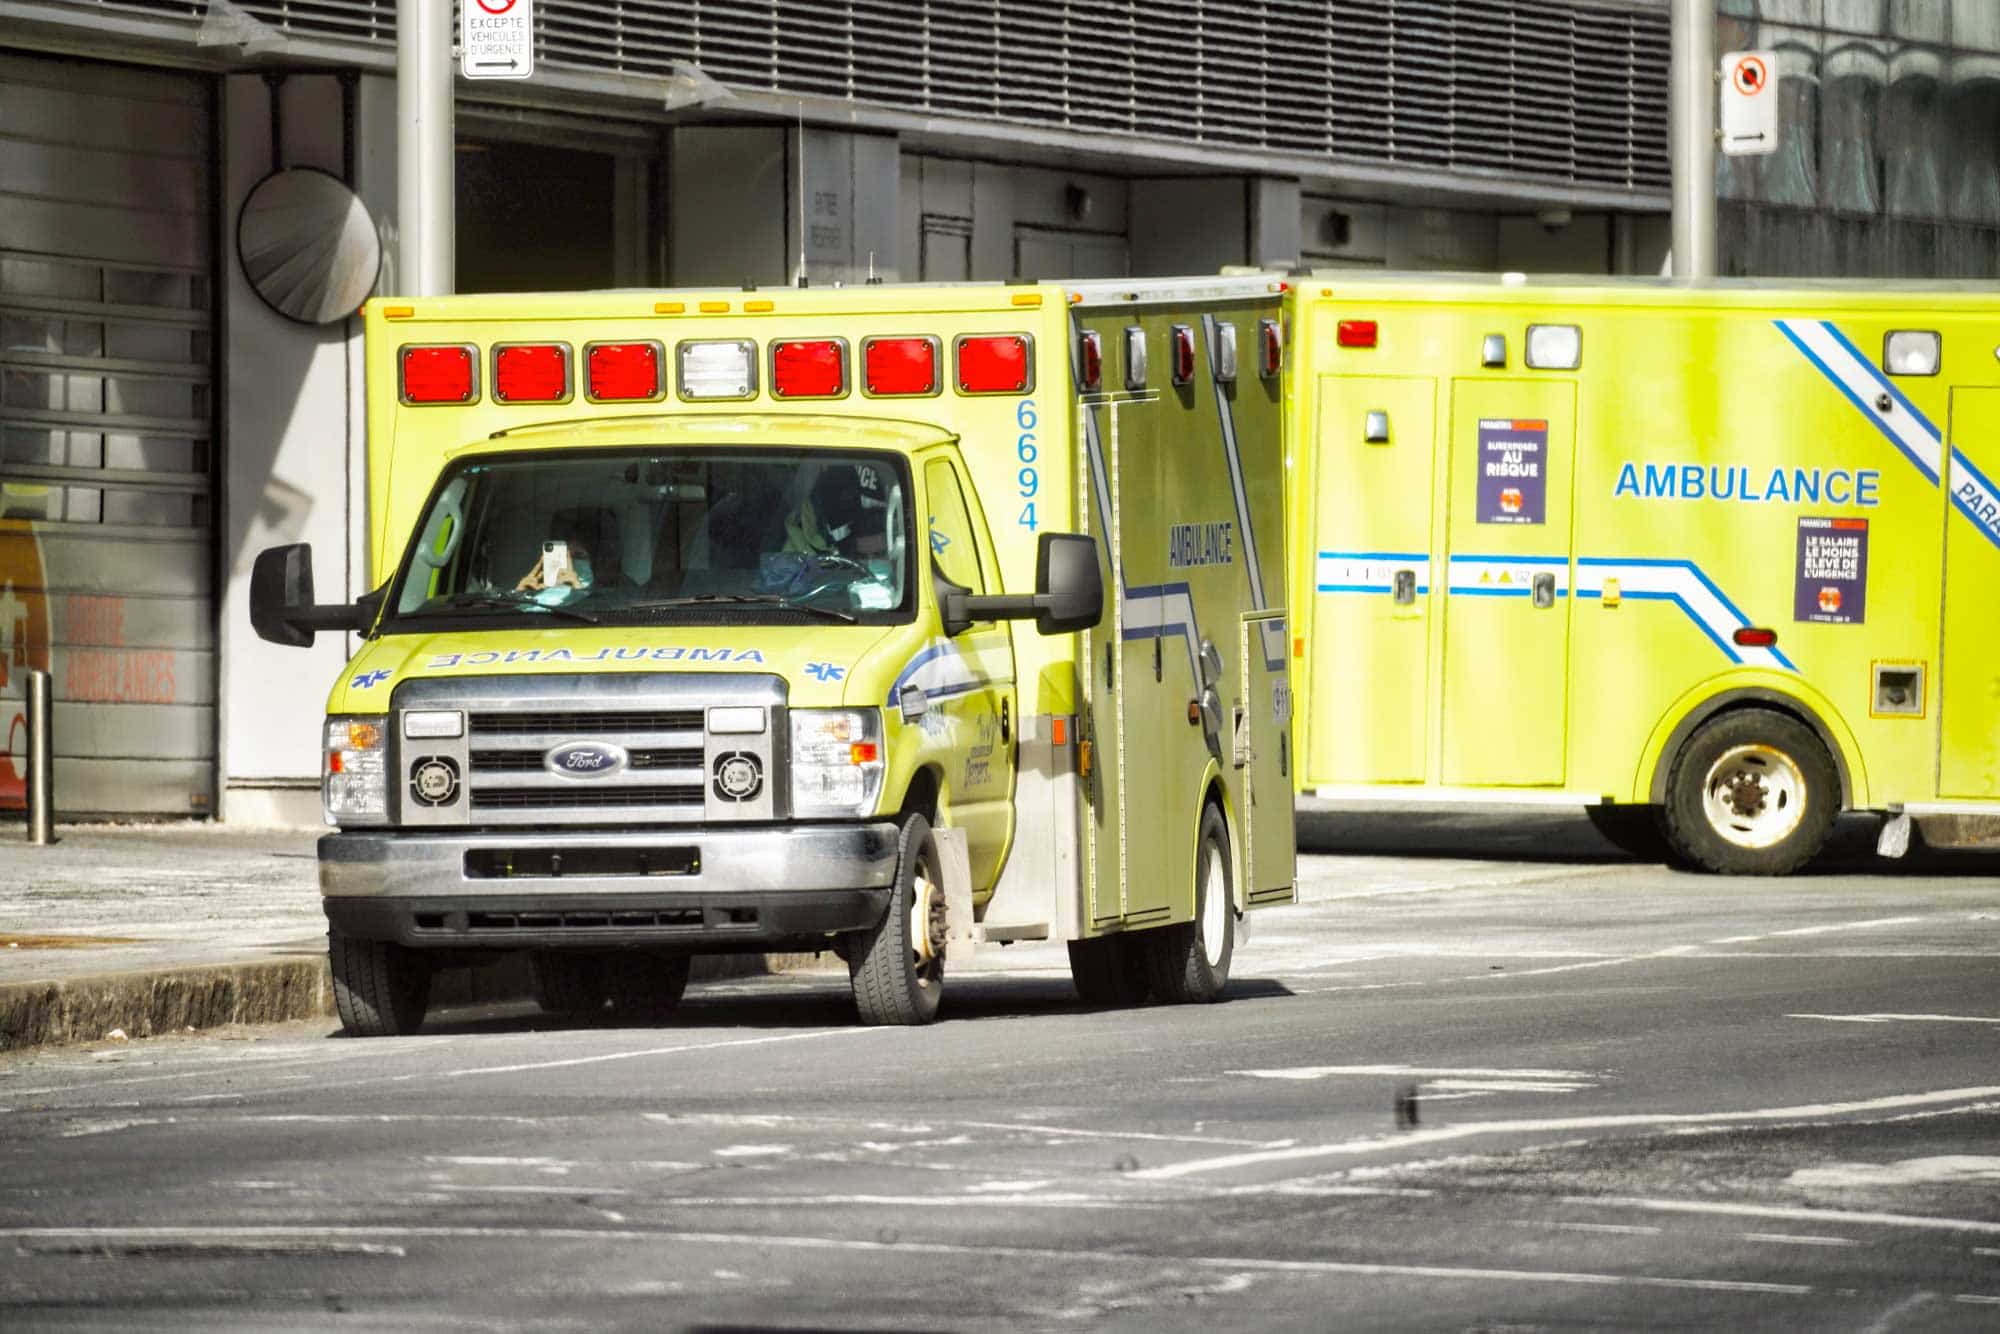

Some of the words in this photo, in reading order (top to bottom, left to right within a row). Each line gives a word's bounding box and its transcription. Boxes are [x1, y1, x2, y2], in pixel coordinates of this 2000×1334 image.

[1017, 399, 1039, 532] 6694
[1502, 451, 1523, 464] AU
[1486, 463, 1539, 477] RISQUE
[1614, 462, 1881, 506] AMBULANCE
[1168, 522, 1232, 567] AMBULANCE
[1821, 548, 1859, 558] MOINS
[566, 751, 604, 768] Ford
